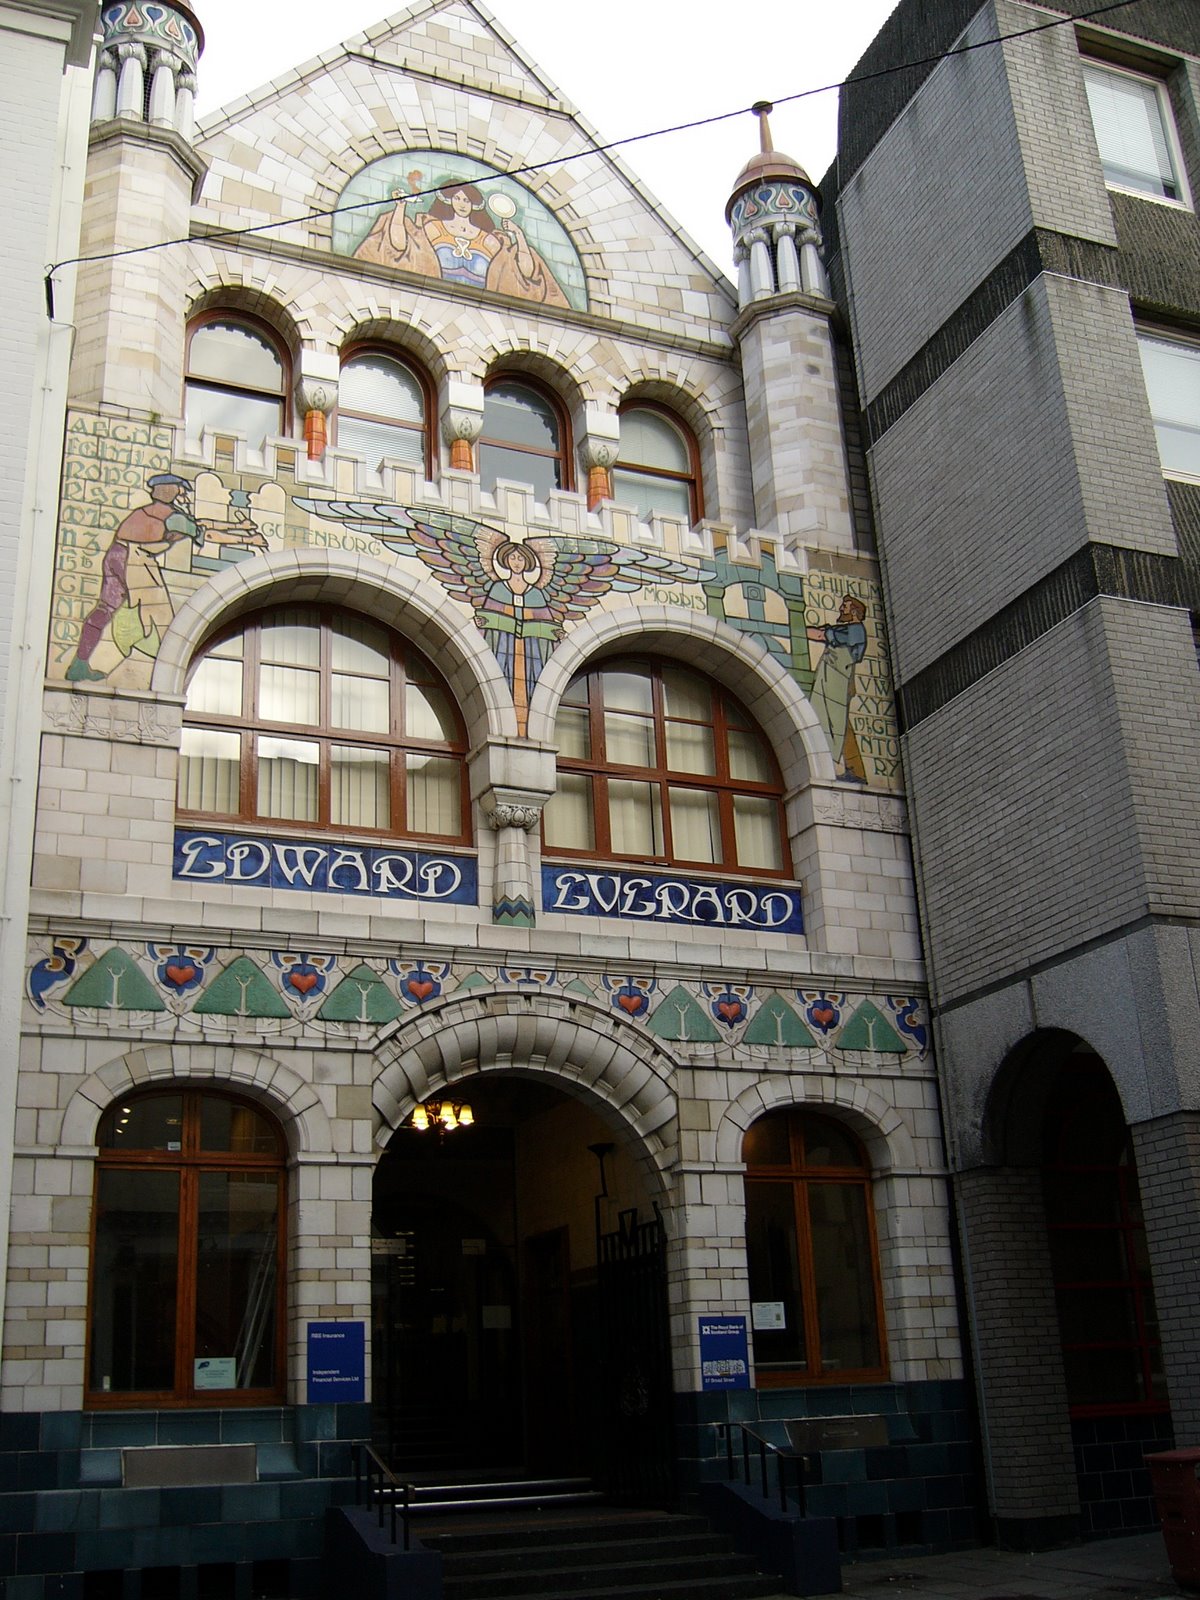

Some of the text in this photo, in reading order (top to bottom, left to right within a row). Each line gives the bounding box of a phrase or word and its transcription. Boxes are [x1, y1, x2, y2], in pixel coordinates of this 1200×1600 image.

[261, 521, 381, 556] GUTENBURG
[643, 587, 706, 611] MORRIS
[178, 836, 462, 898] EDWARD
[552, 873, 794, 927] EVERARD
